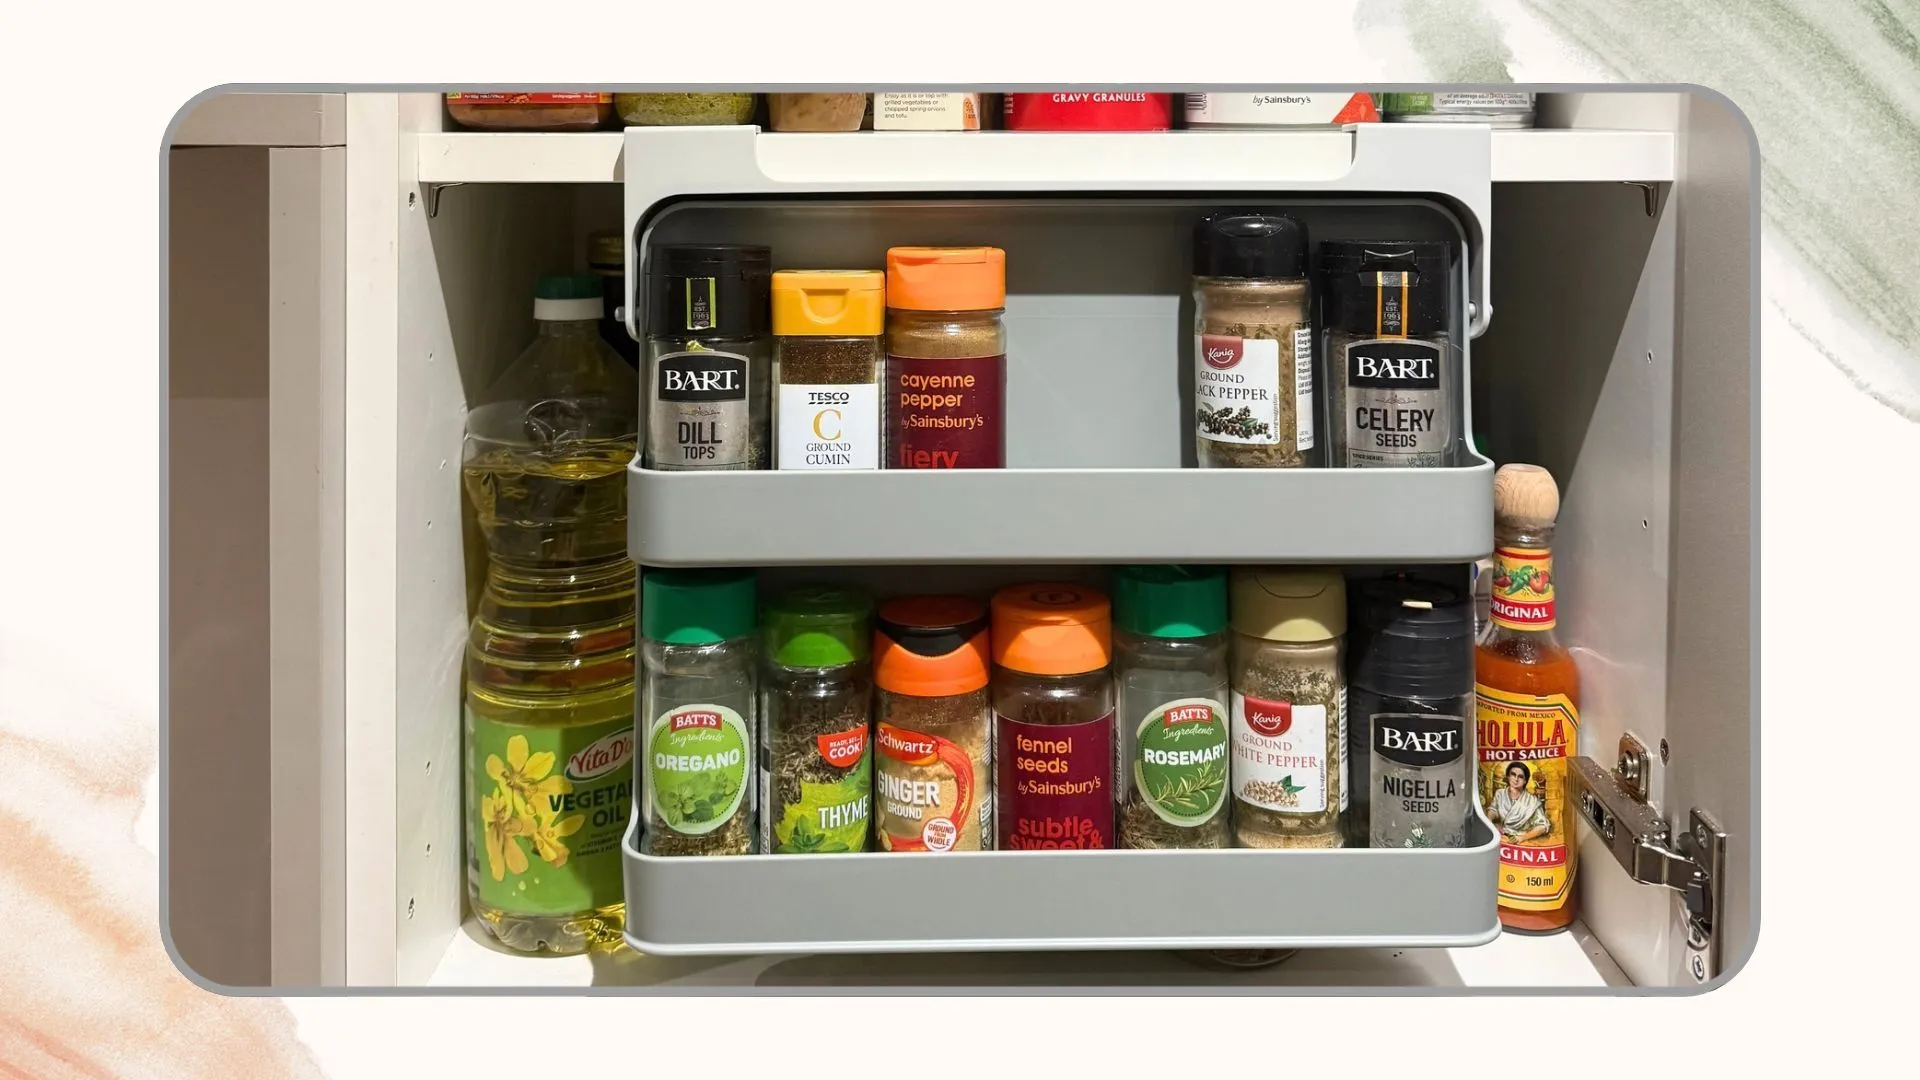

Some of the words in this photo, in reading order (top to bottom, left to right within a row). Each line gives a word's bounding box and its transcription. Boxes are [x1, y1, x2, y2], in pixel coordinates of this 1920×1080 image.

[1052, 93, 1090, 103] GRAVY
[1093, 92, 1146, 102] GRANULES
[1252, 95, 1264, 106] by
[1264, 95, 1311, 105] Sainsbury's
[900, 374, 975, 391] cayenne
[1200, 370, 1245, 384] GROUND
[808, 392, 850, 401] TESCO
[900, 392, 964, 410] pepper
[1197, 384, 1216, 398] ACK
[1219, 387, 1269, 401] PEPPER
[813, 408, 841, 441] C
[910, 413, 984, 430] Sainsbury's
[1355, 406, 1435, 432] CELERY
[678, 421, 723, 444] DILL
[1375, 433, 1417, 448] SEEDS
[683, 446, 716, 460] TOPS
[806, 443, 851, 452] GROUND
[806, 454, 851, 465] CUMIN
[675, 713, 717, 729] BATTS
[1169, 707, 1209, 722] BATTS
[1252, 712, 1282, 728] Kania
[1507, 709, 1528, 718] FROM
[670, 730, 725, 749] Ingredients
[1162, 726, 1214, 742] Ingredients
[1242, 732, 1293, 752] GROUND
[1016, 734, 1073, 754] fennel
[570, 743, 609, 773] Vita
[610, 736, 633, 762] D'o
[655, 748, 741, 773] OREGANO
[1144, 740, 1226, 766] ROSEMARY
[1267, 753, 1318, 769] PEPPER
[1485, 750, 1515, 761] HOT
[1519, 747, 1560, 760] SAUCE
[1016, 756, 1069, 774] seeds
[877, 769, 941, 806] GINGER
[1017, 781, 1029, 795] by
[1028, 775, 1101, 795] Sainsbury's
[1383, 775, 1456, 800] NIGELLA
[817, 794, 869, 830] THYME
[887, 803, 922, 820] GROUND
[1402, 799, 1439, 814] SEEDS
[592, 805, 625, 828] OIL
[928, 823, 955, 834] GROUND
[1018, 816, 1094, 839] subtle
[927, 836, 951, 847] WHOLE
[1500, 847, 1558, 863] GINAL
[1526, 876, 1542, 887] 150
[1543, 875, 1554, 886] ml
